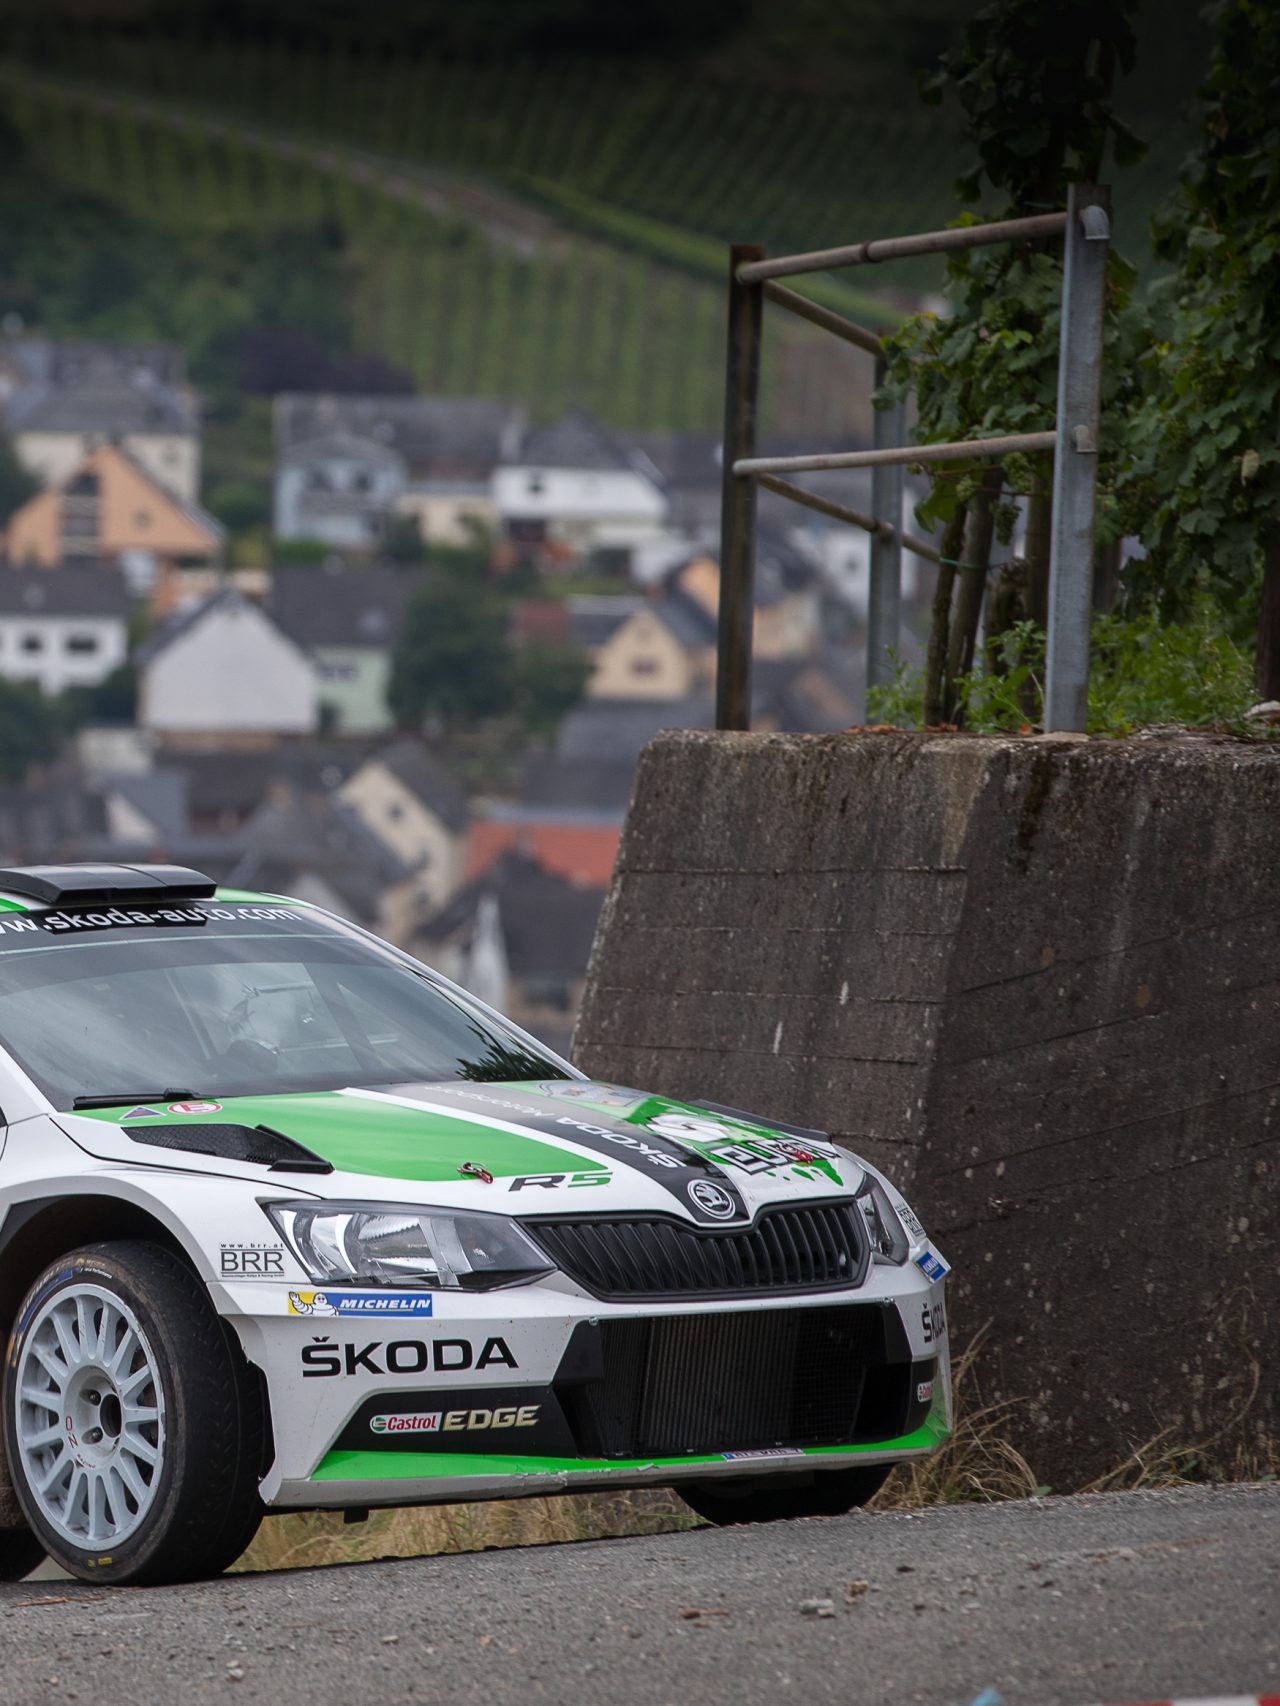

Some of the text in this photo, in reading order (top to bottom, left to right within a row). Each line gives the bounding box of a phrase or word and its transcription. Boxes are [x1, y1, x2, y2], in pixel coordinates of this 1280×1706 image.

[508, 1171, 613, 1192] R5
[221, 1251, 284, 1272] BRR
[340, 1298, 431, 1310] MICHELIN
[301, 1336, 520, 1378] ŠKODA
[387, 1405, 542, 1432] Castrol EDGE
